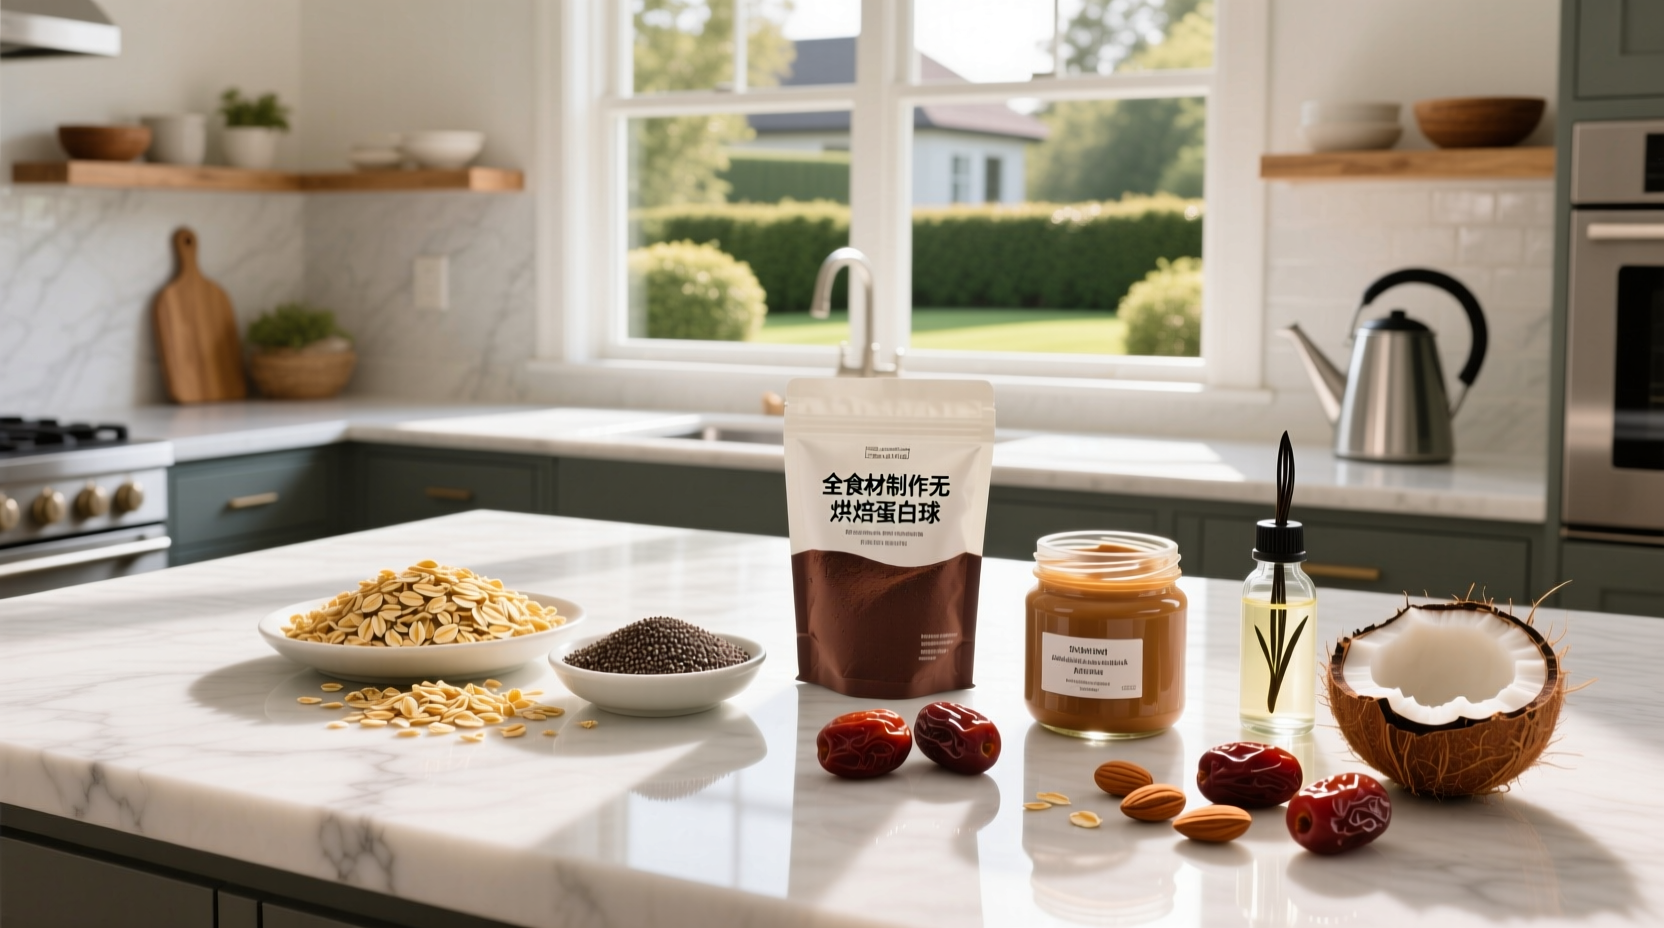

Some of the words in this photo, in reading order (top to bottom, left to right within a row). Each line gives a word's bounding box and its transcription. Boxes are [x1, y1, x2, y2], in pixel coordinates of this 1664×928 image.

[822, 472, 951, 498] 全食材制作无
[830, 499, 941, 525] 烘焙蛋白球
